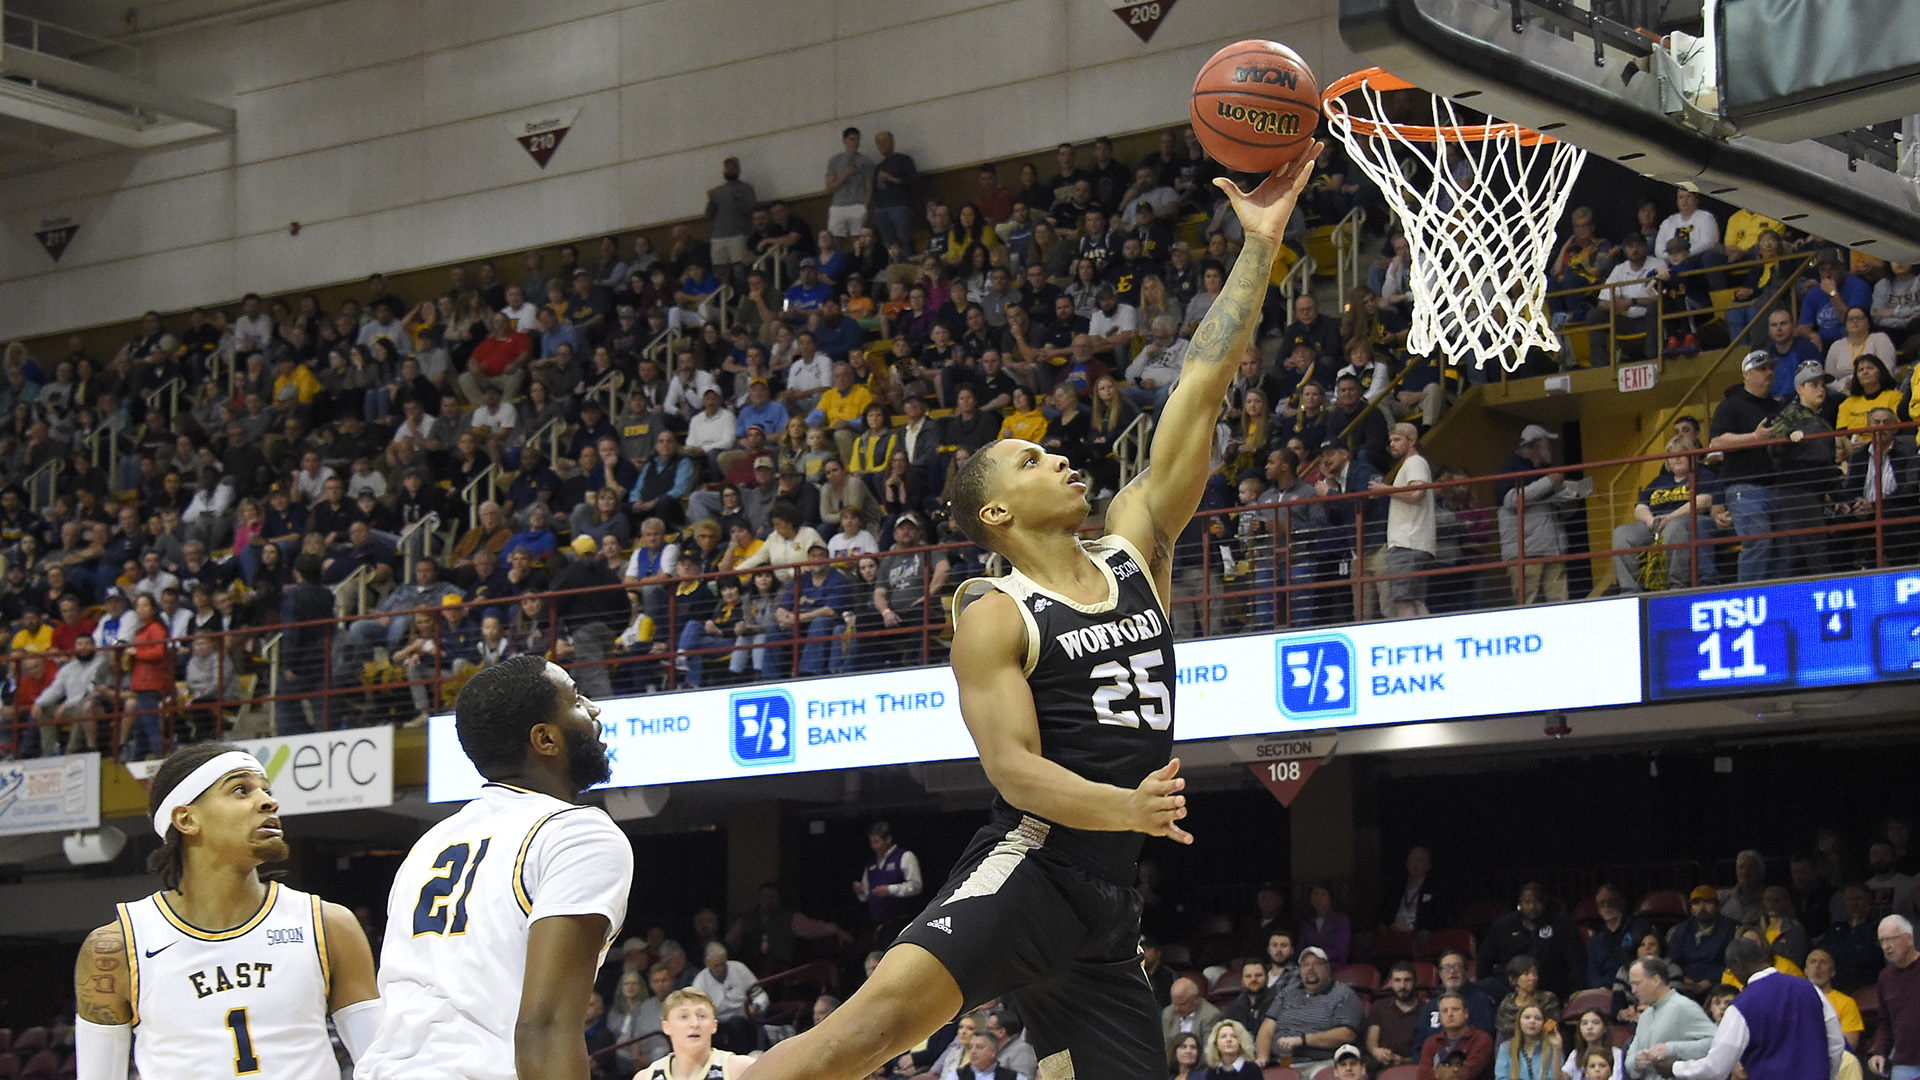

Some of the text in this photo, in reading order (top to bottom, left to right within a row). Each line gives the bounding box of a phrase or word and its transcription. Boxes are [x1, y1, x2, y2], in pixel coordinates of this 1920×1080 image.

[1130, 3, 1160, 25] 209
[1236, 65, 1299, 91] NCAA
[1217, 100, 1300, 135] Wilson
[529, 133, 556, 152] 210
[1624, 366, 1649, 389] EXIT
[1812, 588, 1856, 612] TOL
[1690, 595, 1767, 632] ETSU
[1056, 609, 1162, 661] WOFFORD
[1371, 633, 1543, 668] FIFTH THIRD
[1698, 628, 1767, 681] 11
[1175, 663, 1229, 685] HIRD
[1371, 672, 1446, 697] BANK
[1089, 649, 1172, 731] 25
[807, 691, 945, 719] FIFTH THIRD
[626, 715, 691, 736] THIRD
[807, 725, 867, 746] BANK
[1256, 741, 1312, 757] SECTION
[1267, 761, 1300, 782] 108
[412, 836, 493, 939] 21
[188, 962, 273, 999] EAST
[224, 1006, 262, 1076] 1
